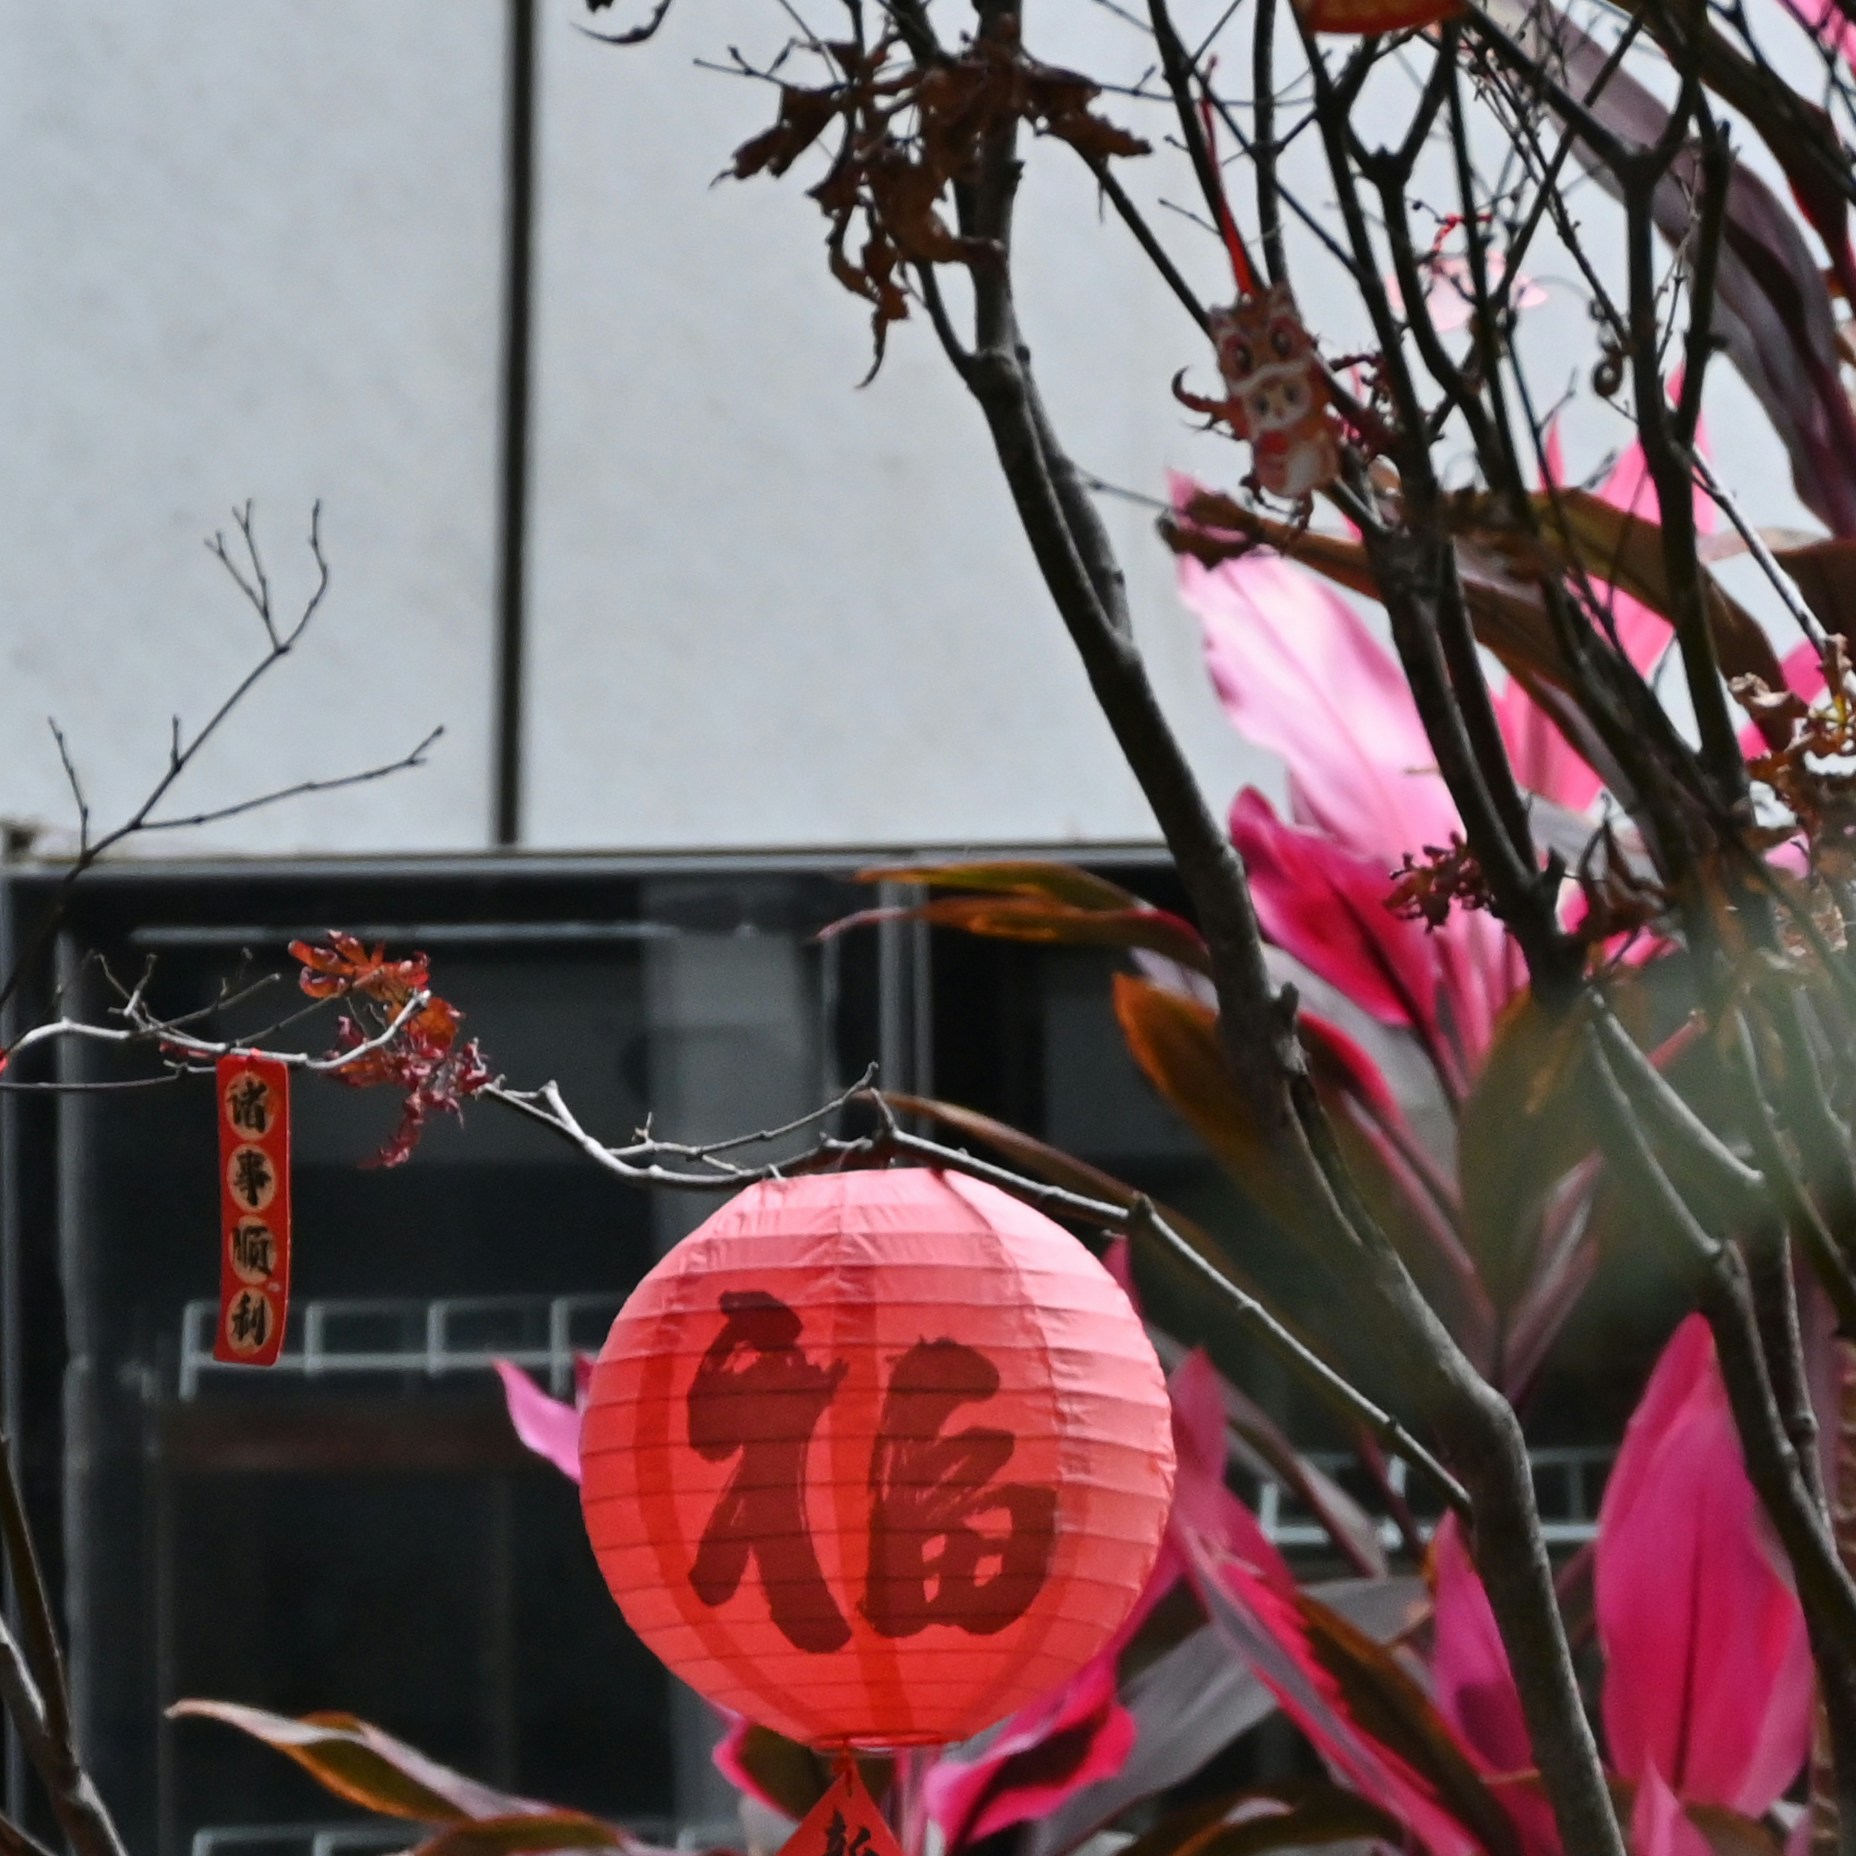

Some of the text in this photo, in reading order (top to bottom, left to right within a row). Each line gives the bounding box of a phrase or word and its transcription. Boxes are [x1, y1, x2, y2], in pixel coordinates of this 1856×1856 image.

[225, 1080, 272, 1347] 诸事顺利
[687, 1290, 1058, 1654] 福
